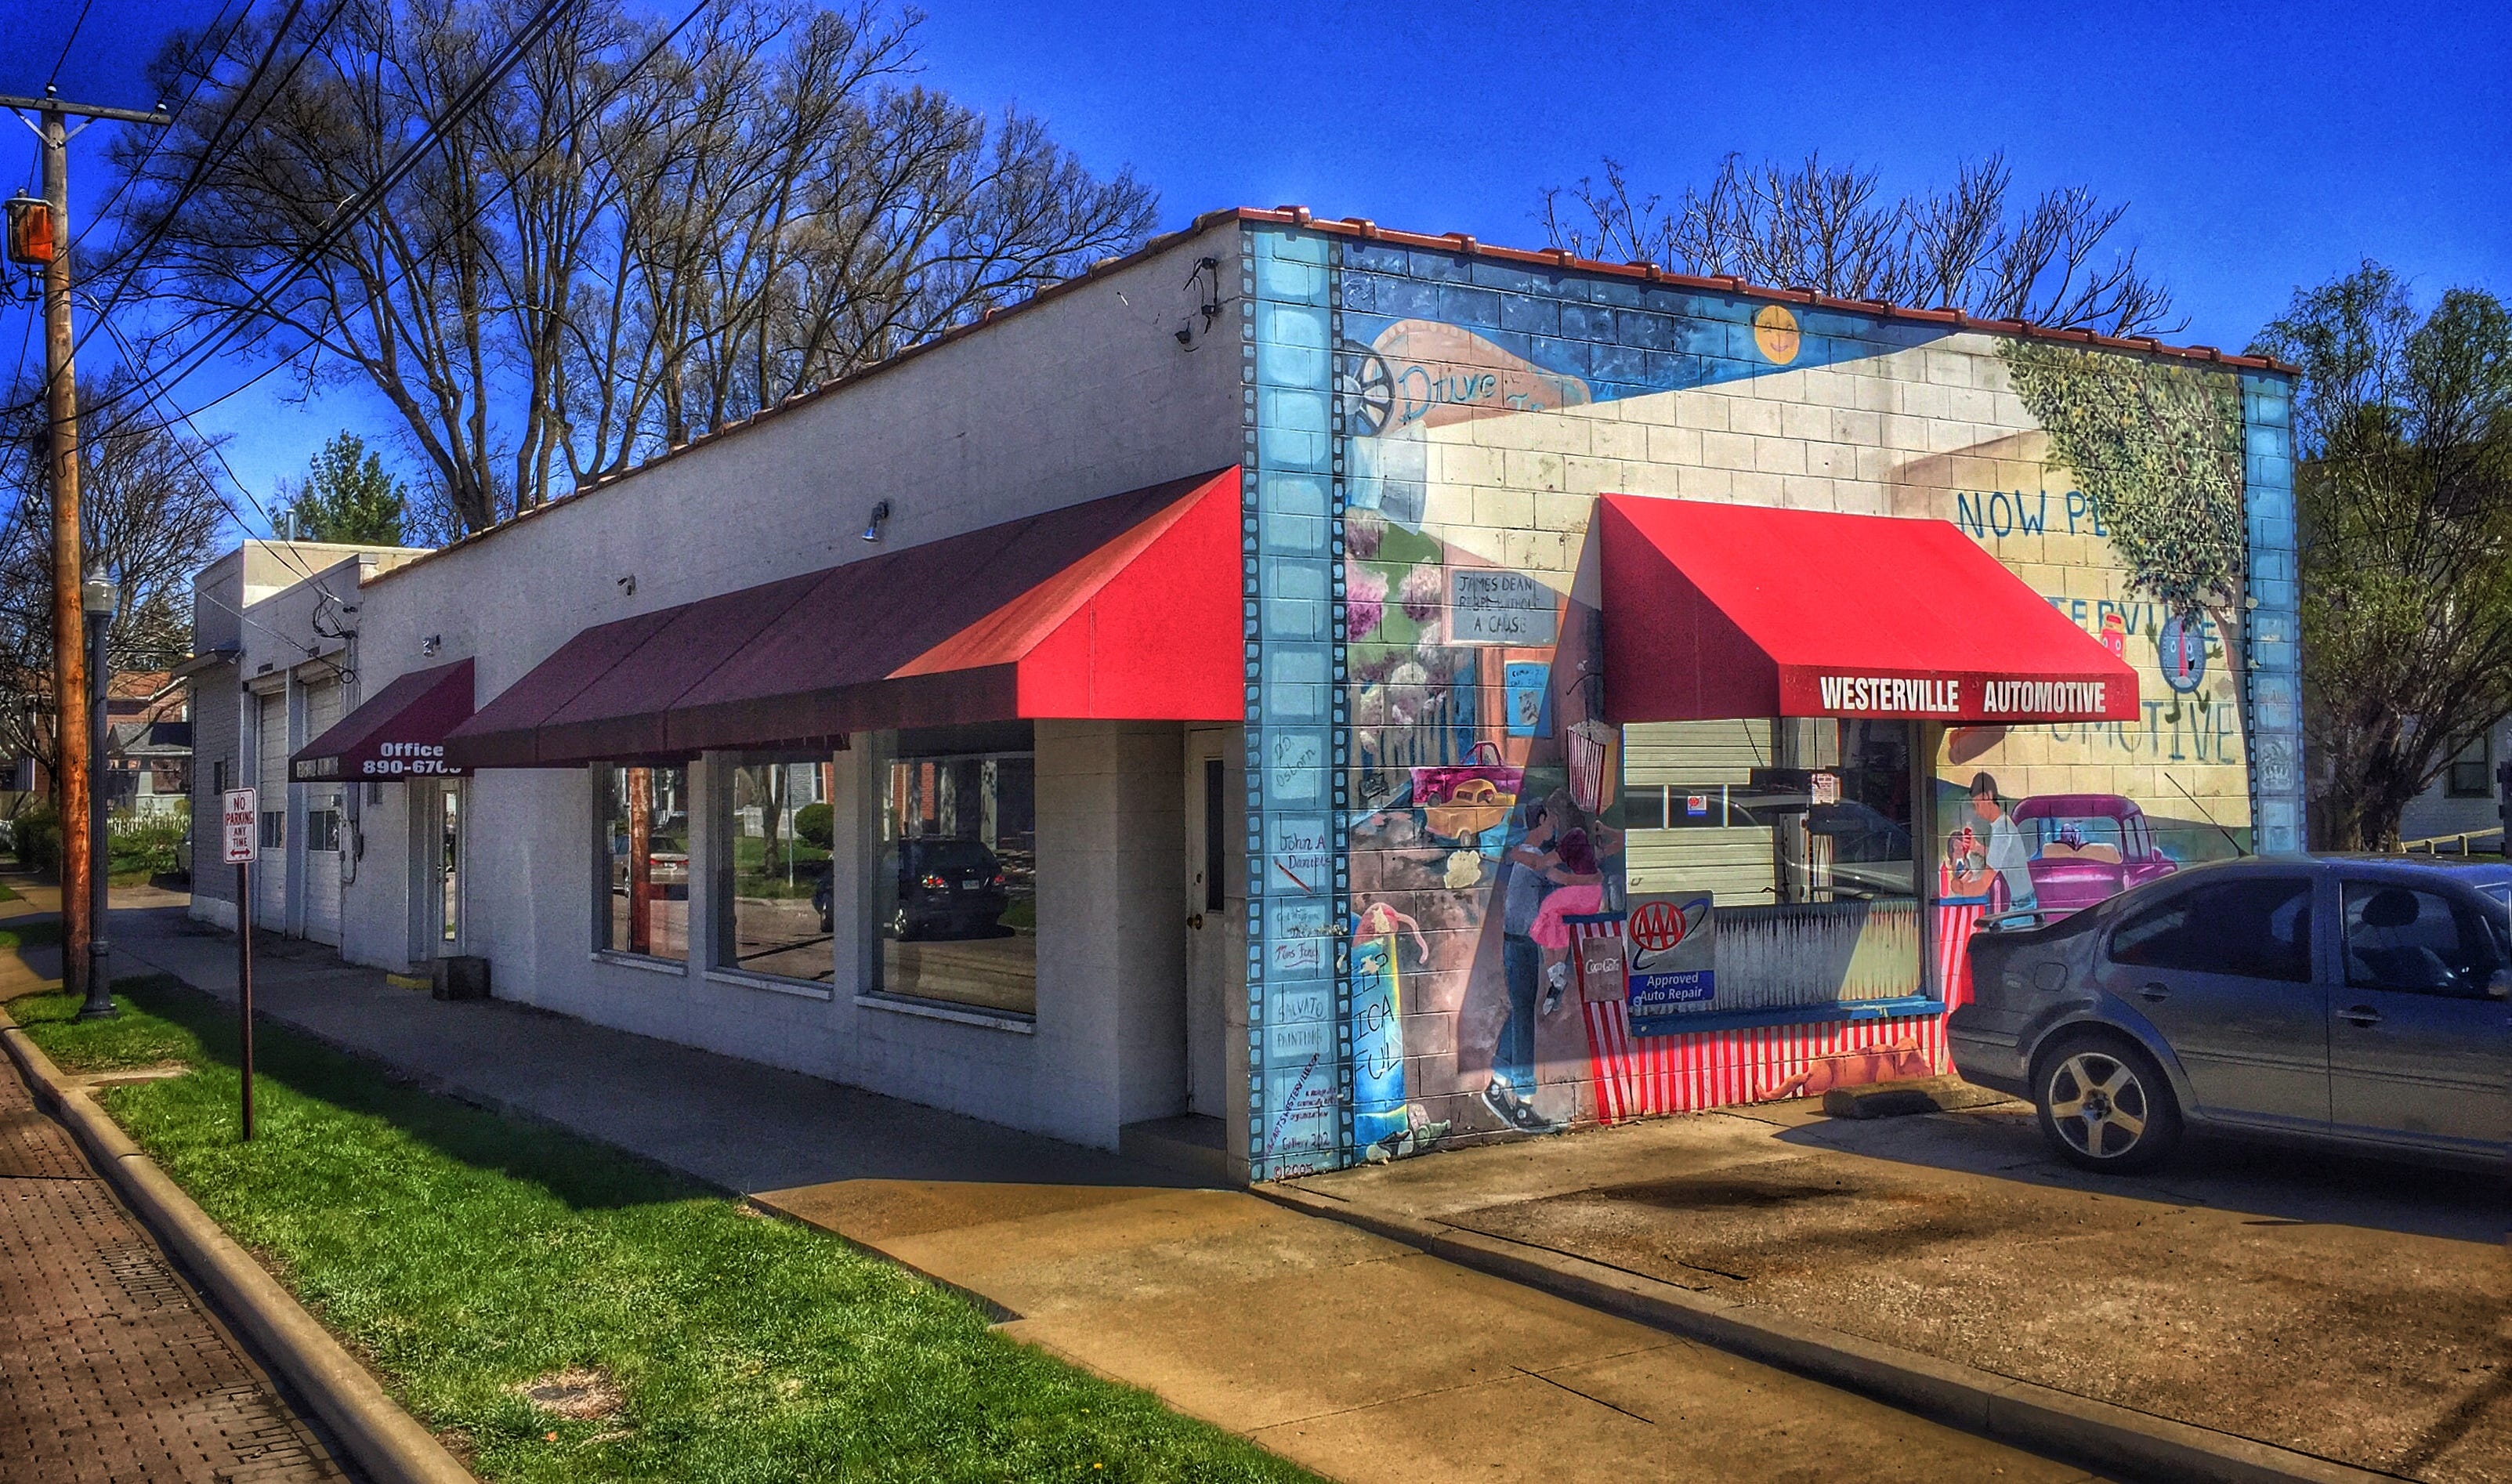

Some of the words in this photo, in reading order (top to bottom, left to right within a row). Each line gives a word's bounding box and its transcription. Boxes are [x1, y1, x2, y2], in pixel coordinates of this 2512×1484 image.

[1397, 365, 1497, 423] Drive
[1957, 489, 2047, 539] NOW
[1458, 575, 1498, 592] JAMES
[1500, 577, 1533, 592] DEAN
[1474, 616, 1482, 632] A
[1489, 615, 1526, 633] CAUSE
[1819, 676, 1960, 713] WESTERVILLE
[1983, 680, 2106, 714] AUTOMOTIVE
[379, 742, 443, 758] Office
[233, 796, 246, 811] NO
[225, 810, 253, 827] PARKING
[233, 827, 247, 836] ANY
[232, 837, 248, 847] TIME
[1280, 832, 1313, 852] John
[1316, 834, 1327, 850] A
[1633, 901, 1684, 950] AAA
[1646, 972, 1699, 990] Approved
[1640, 990, 1666, 1001] Auto
[1668, 986, 1703, 1001] Repair
[1285, 1162, 1314, 1176] 2005
